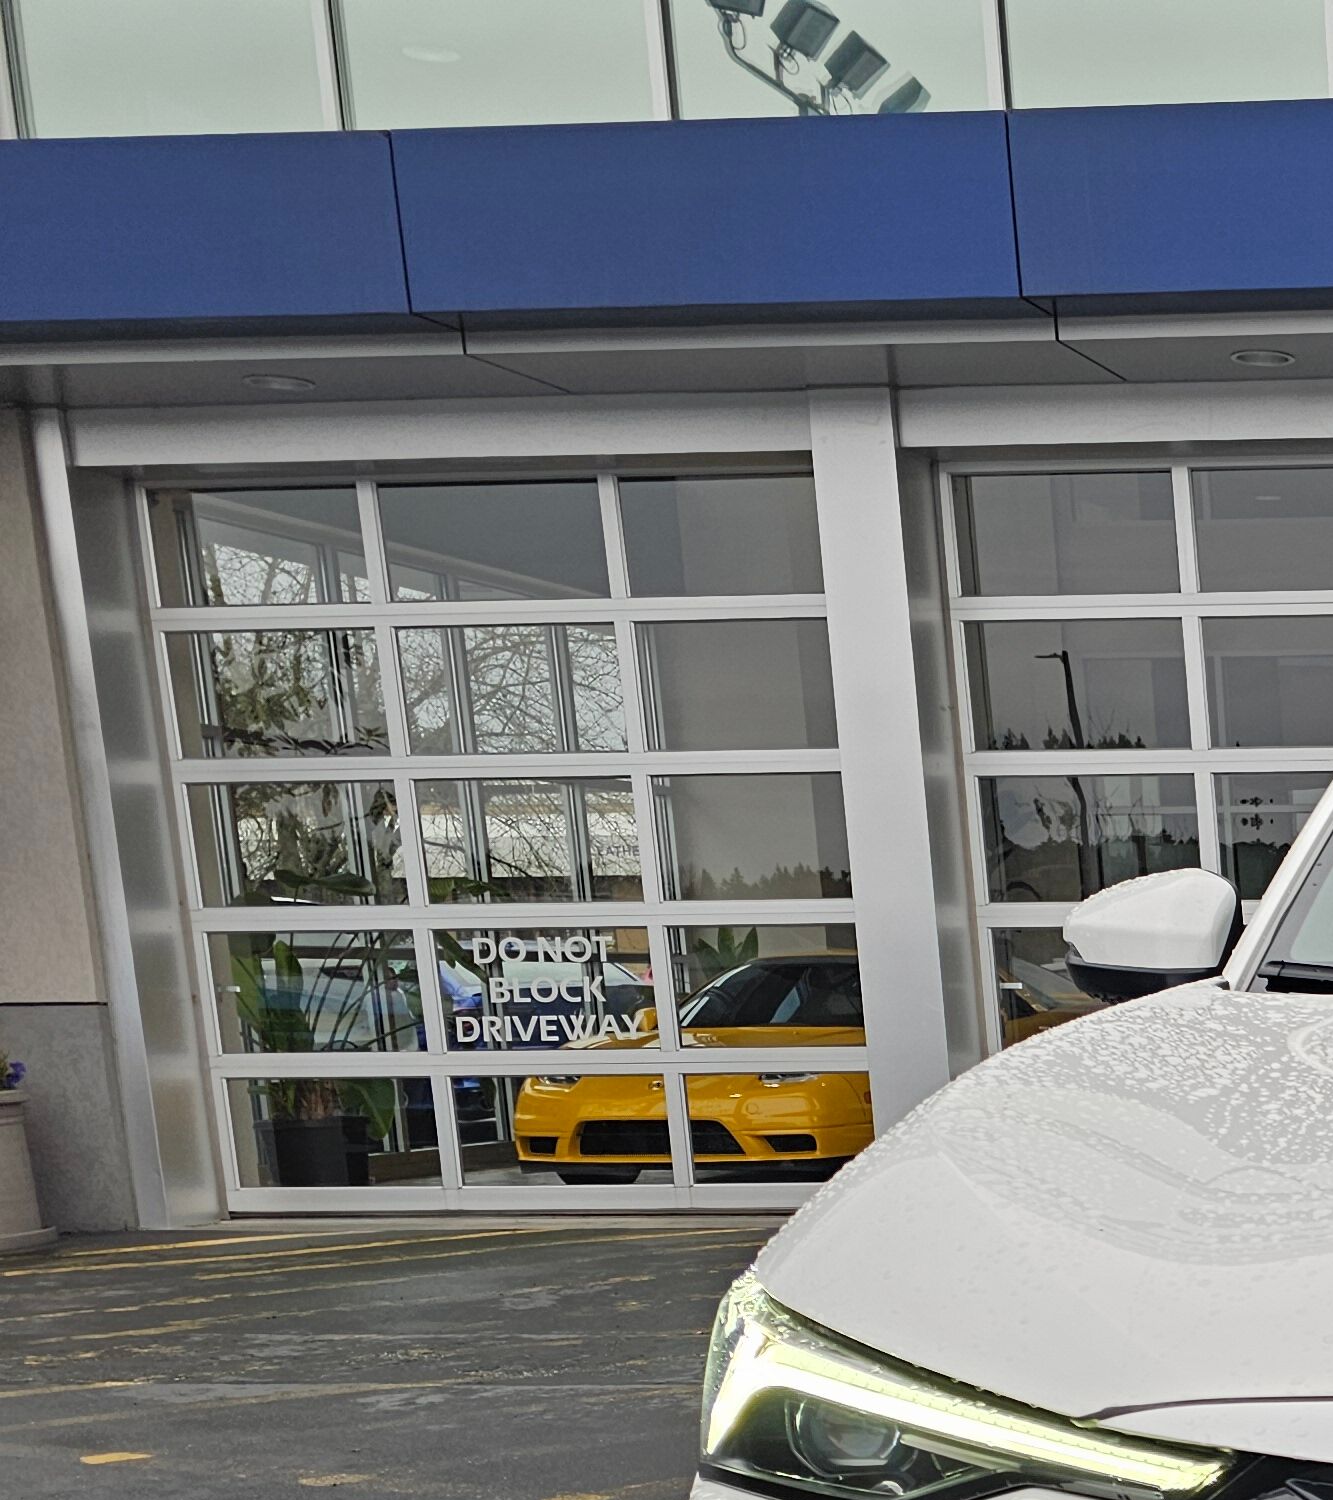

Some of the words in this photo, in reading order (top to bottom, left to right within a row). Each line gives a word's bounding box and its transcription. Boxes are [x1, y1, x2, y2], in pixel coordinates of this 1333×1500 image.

[472, 937, 527, 965] DO
[537, 936, 613, 963] NOT
[489, 976, 606, 1003] BLOCK
[456, 1013, 643, 1043] DRIVEWAY
